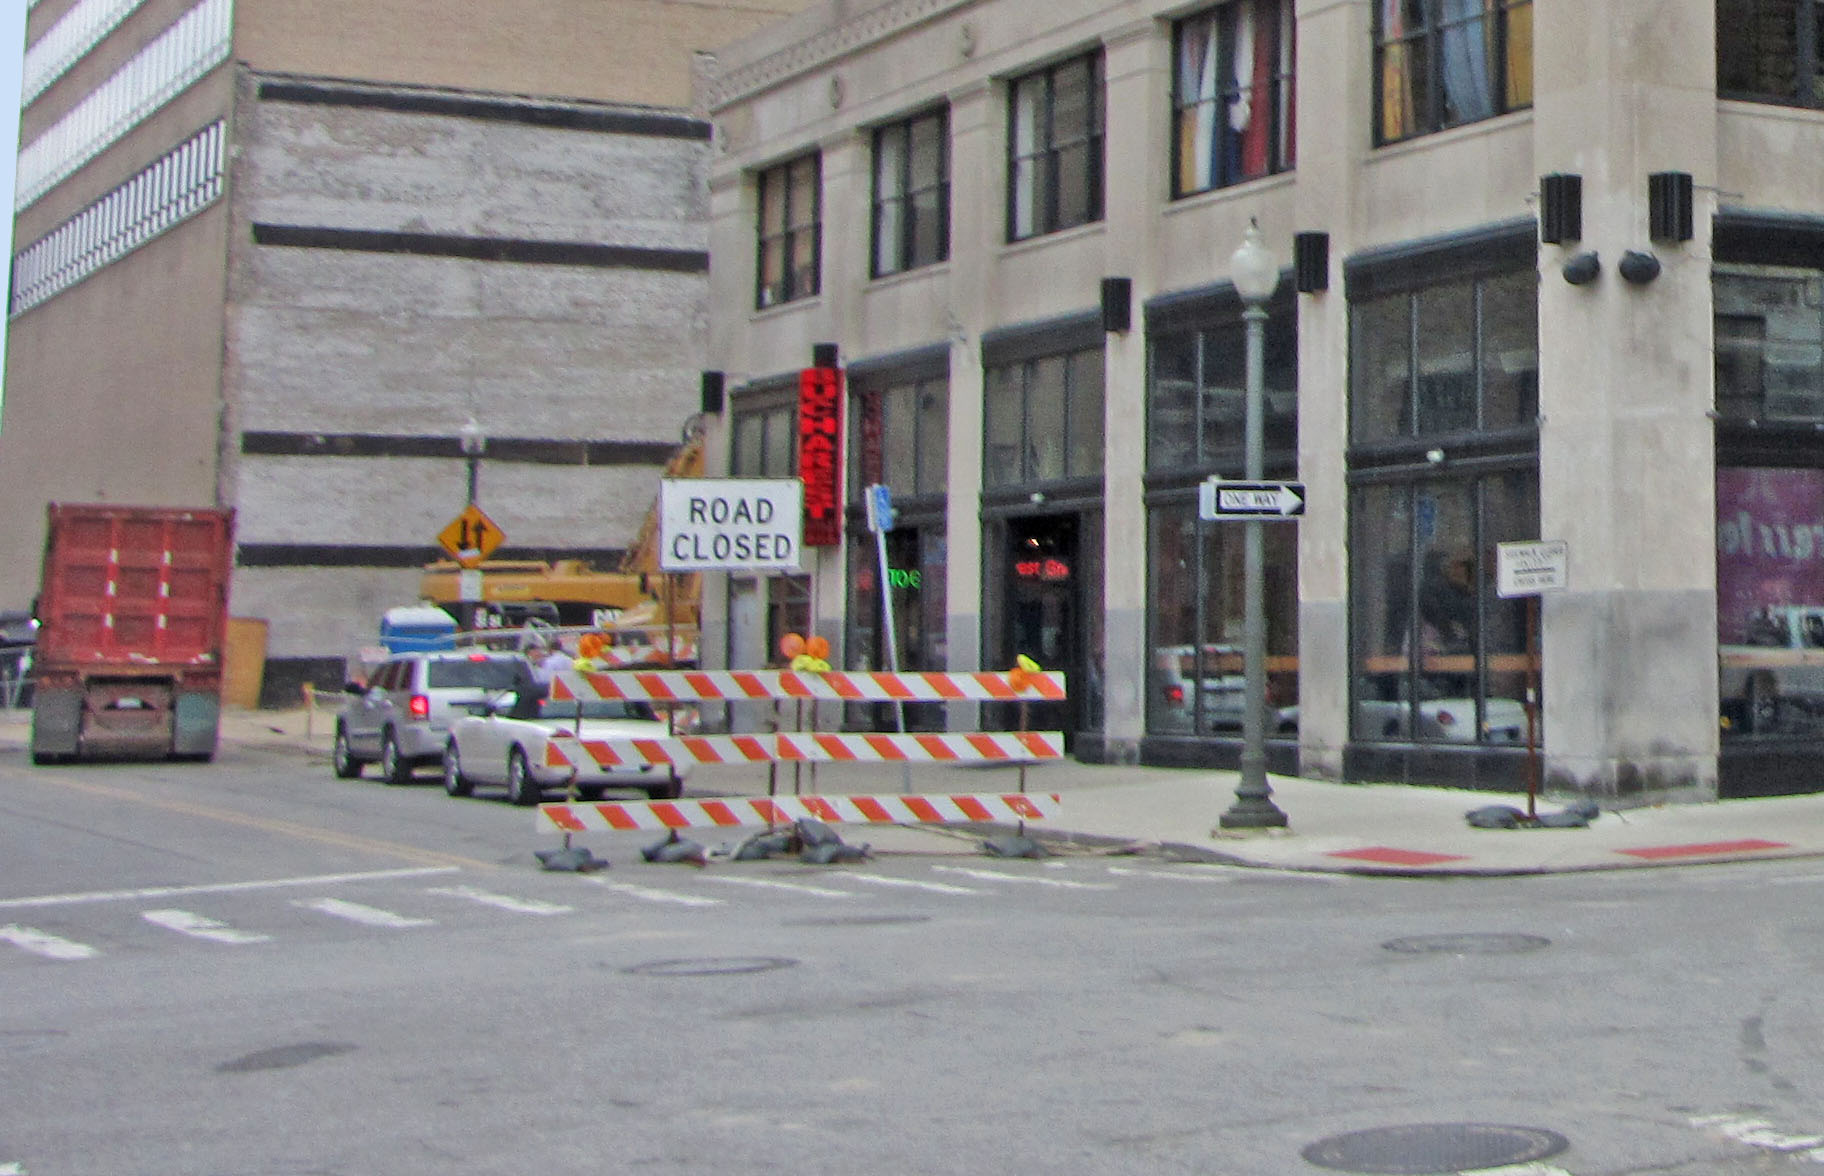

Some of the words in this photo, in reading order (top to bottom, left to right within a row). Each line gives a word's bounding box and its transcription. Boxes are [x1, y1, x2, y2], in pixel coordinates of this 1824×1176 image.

[690, 497, 774, 524] ROAD
[1254, 491, 1277, 506] WAY
[673, 533, 791, 560] CLOSED
